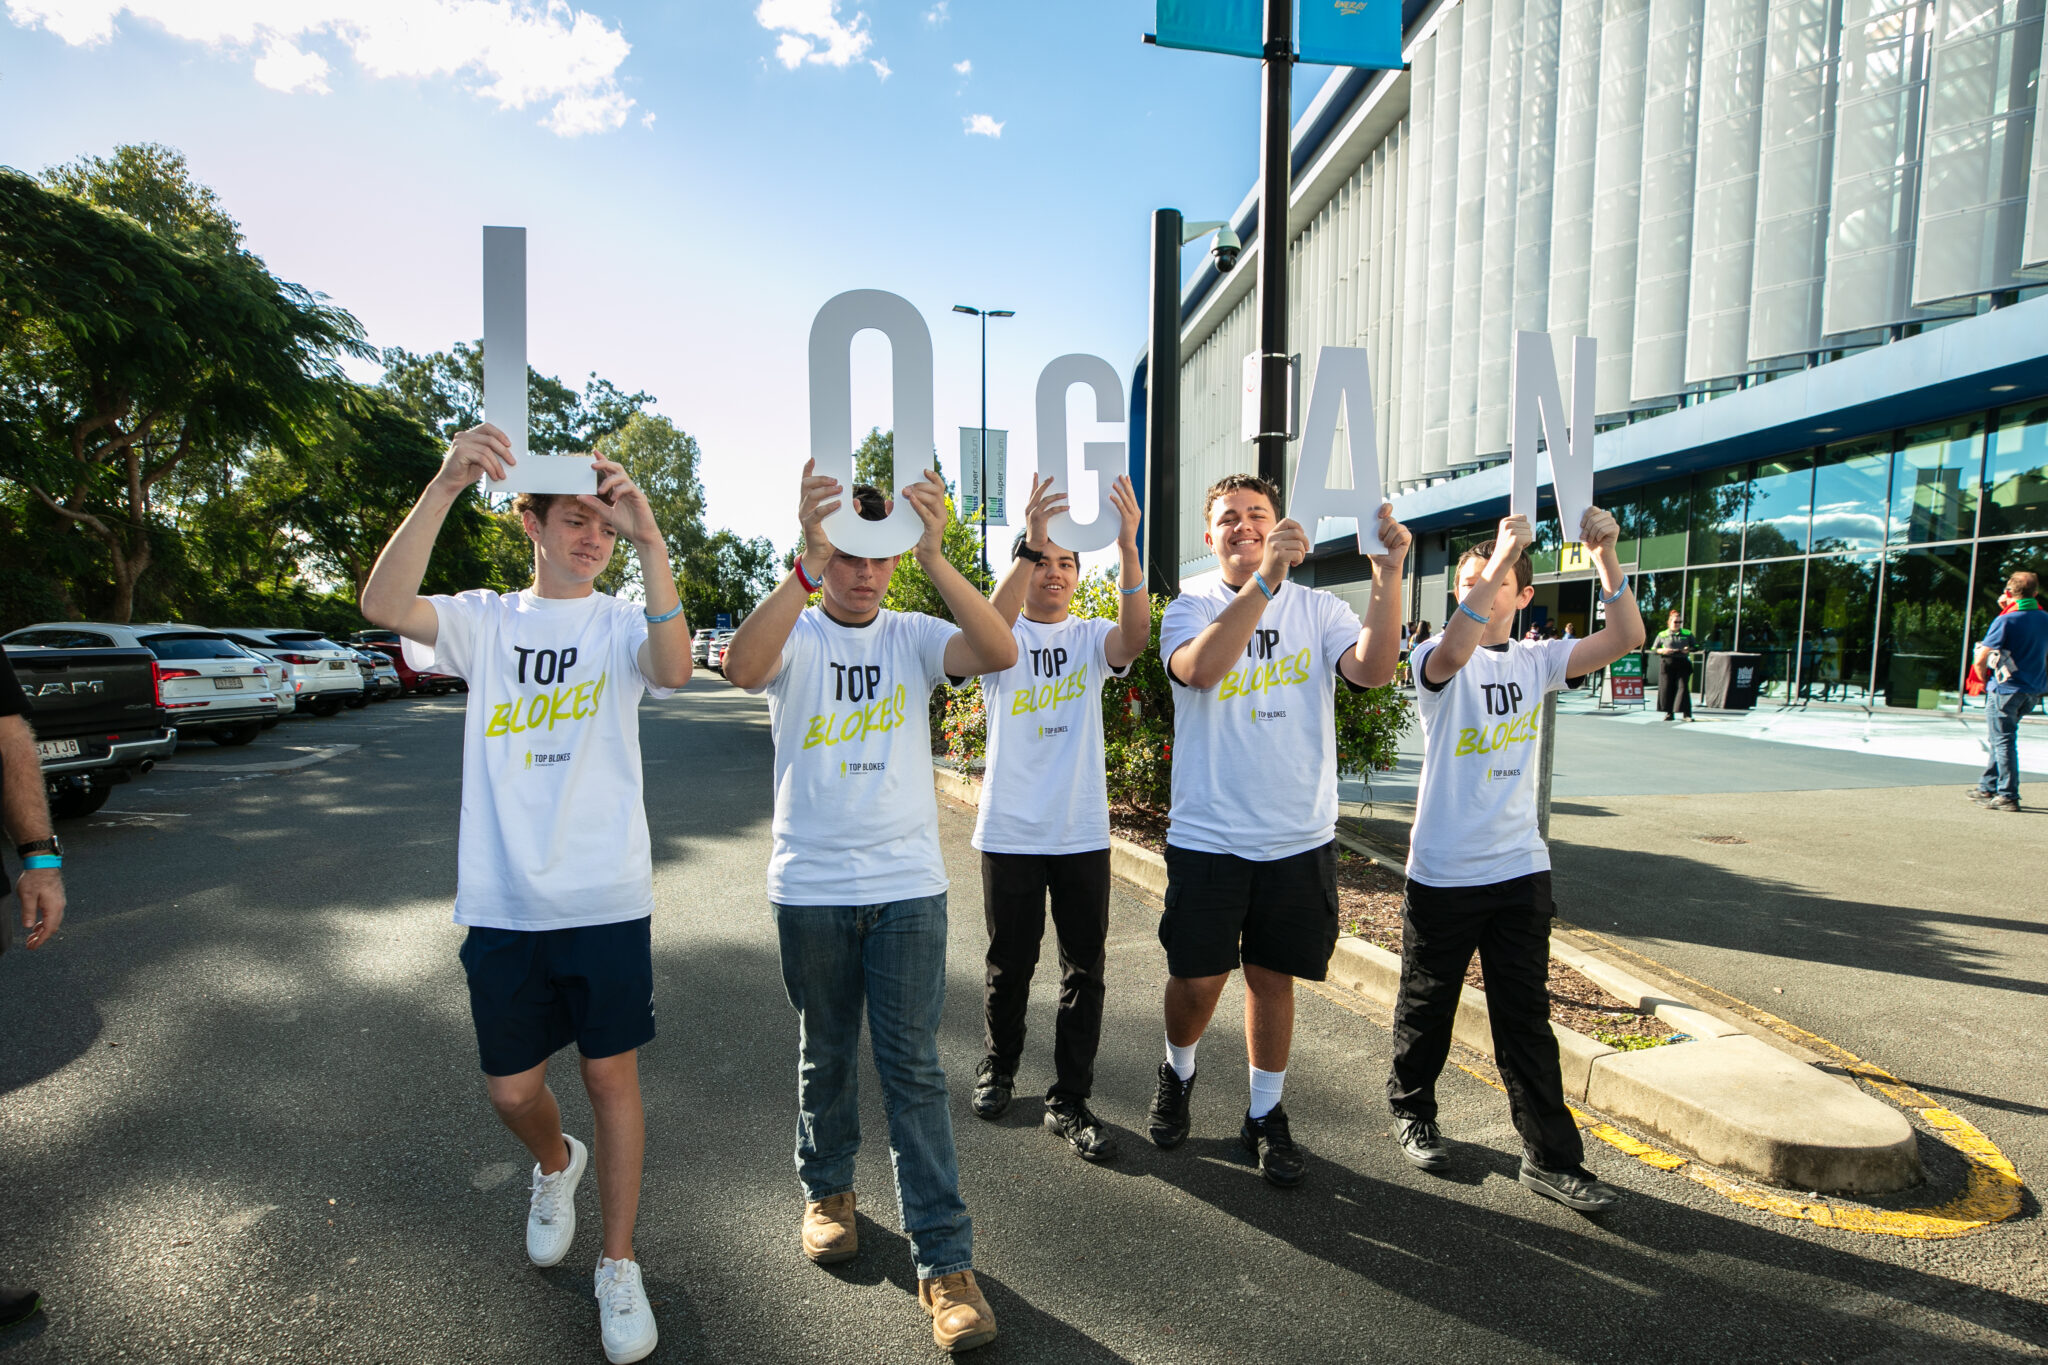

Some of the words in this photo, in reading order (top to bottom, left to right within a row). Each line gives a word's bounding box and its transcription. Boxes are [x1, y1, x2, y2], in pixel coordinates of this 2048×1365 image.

[972, 470, 980, 494] super
[997, 472, 1005, 496] super
[514, 645, 578, 686] TOP
[1030, 647, 1068, 678] TOP
[1218, 647, 1311, 701] BLOKES
[830, 661, 881, 703] TOP
[1011, 663, 1088, 716] BLOKES
[1480, 681, 1523, 716] TOP
[484, 671, 606, 738] BLOKES
[802, 683, 906, 750] BLOKES
[1257, 710, 1266, 718] TOP
[1044, 727, 1054, 735] TOP
[1454, 702, 1542, 757] BLOKES
[534, 754, 548, 763] TOP
[548, 752, 571, 763] BLOKES
[849, 763, 861, 772] TOP
[862, 762, 885, 771] BLOKES
[1493, 769, 1503, 777] TOP
